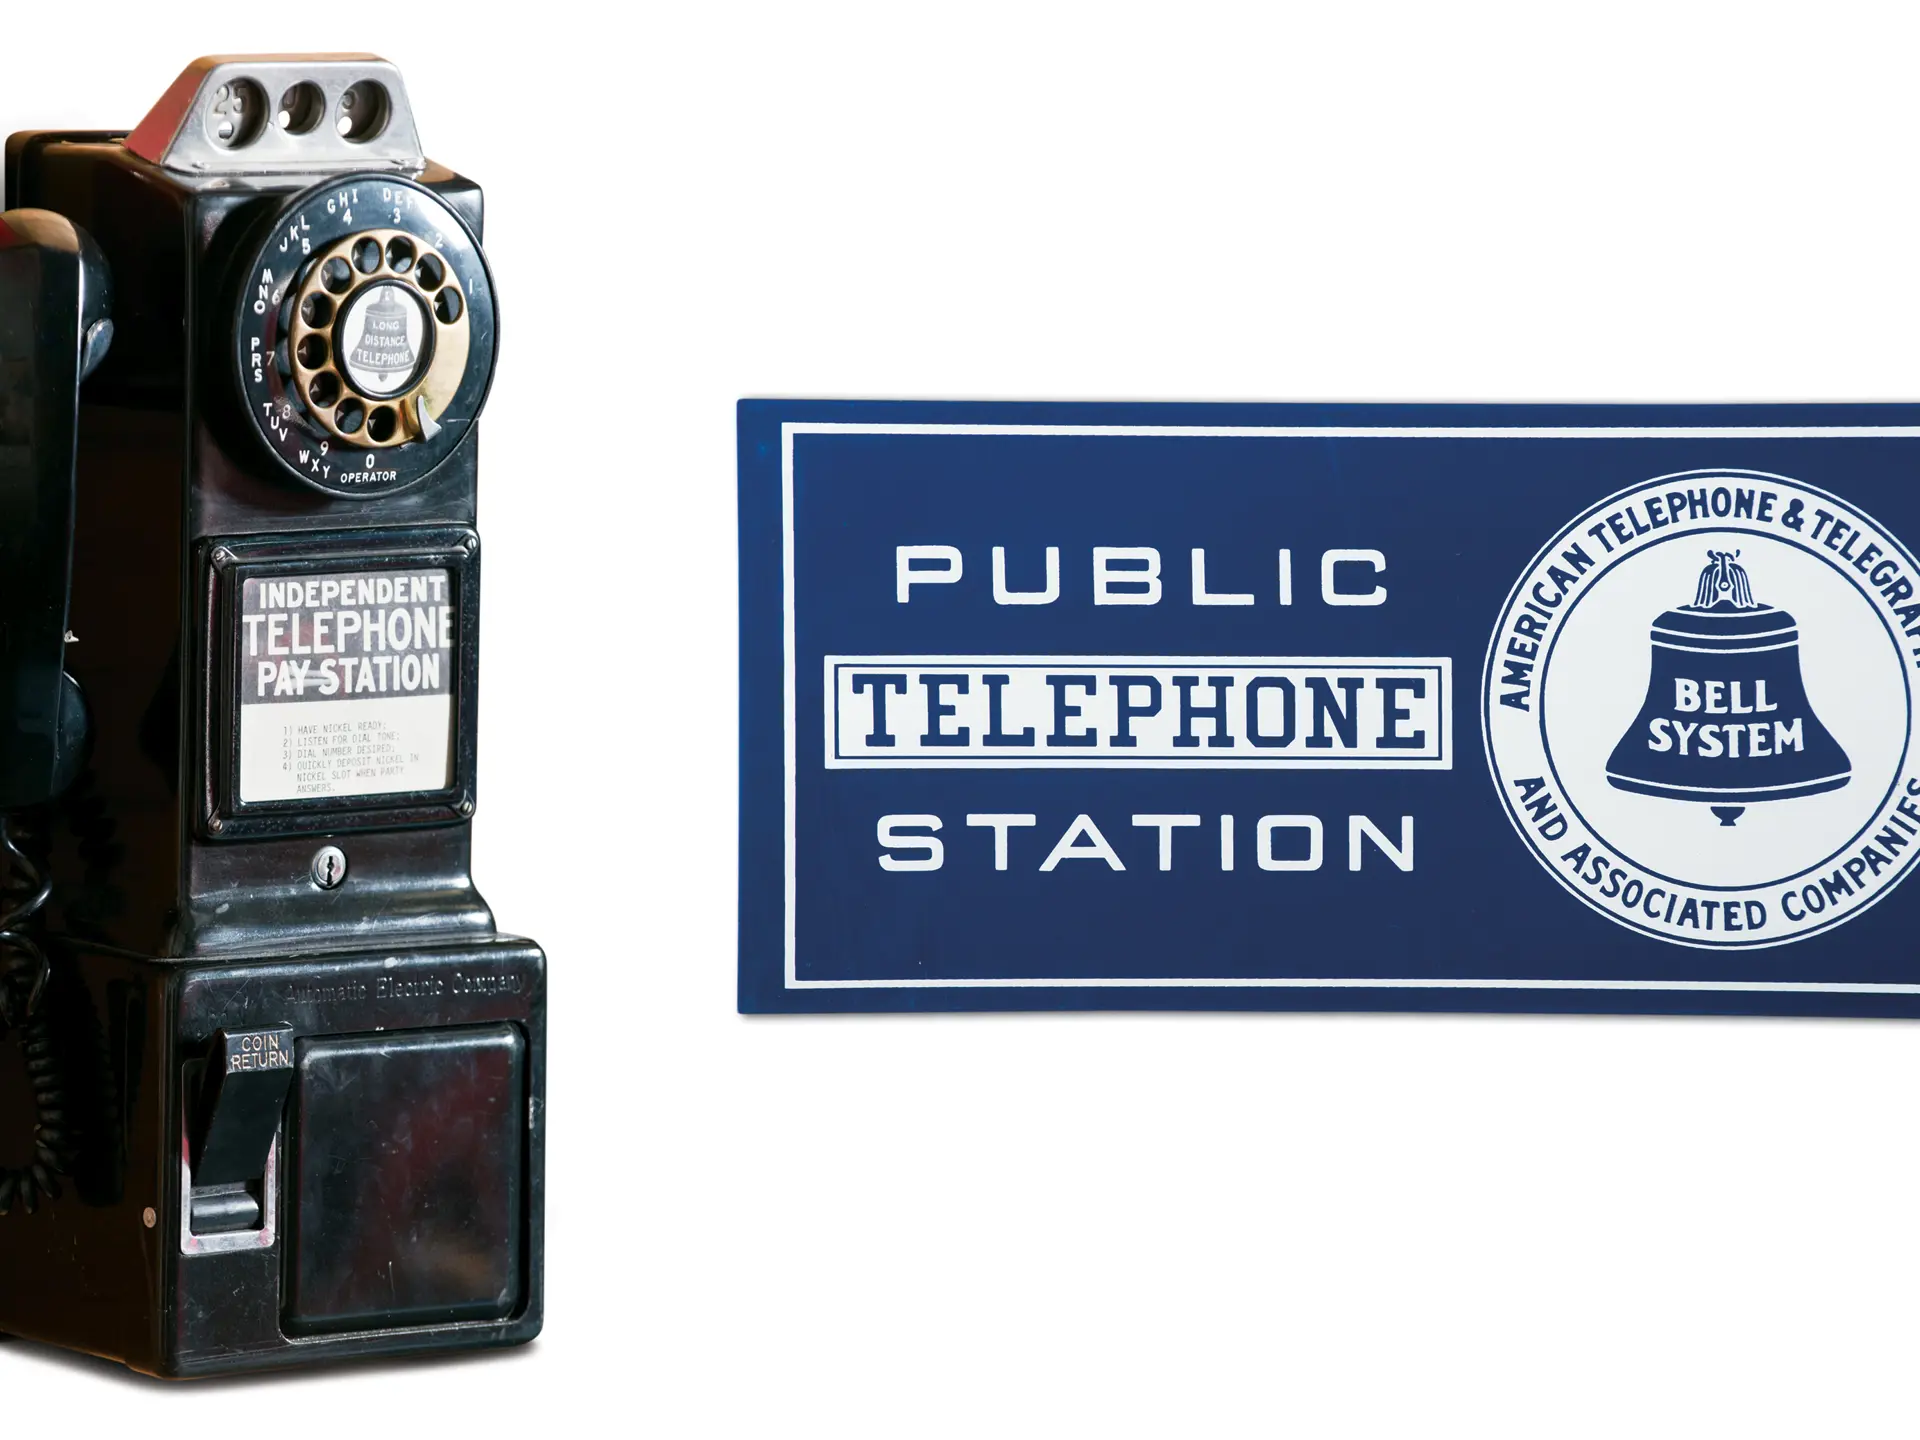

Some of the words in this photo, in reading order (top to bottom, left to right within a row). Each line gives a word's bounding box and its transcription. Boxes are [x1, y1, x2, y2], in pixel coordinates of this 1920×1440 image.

[327, 188, 359, 215] GHI
[343, 208, 352, 226] 4
[393, 207, 401, 224] 3
[279, 215, 310, 252] JKL
[434, 233, 444, 249] 2
[302, 238, 311, 255] 5
[253, 268, 273, 315] MNO
[271, 288, 280, 305] 6
[372, 320, 400, 331] LONG
[365, 334, 406, 348] DISTANCE
[251, 337, 263, 383] PRS
[266, 350, 275, 366] 7
[357, 348, 410, 365] TELEPHONE
[282, 404, 291, 419] 8
[263, 402, 288, 442] TUV
[320, 441, 329, 456] 9
[299, 450, 330, 479] WXY
[340, 470, 397, 484] OPERATOR
[896, 545, 1387, 605] PUBLIC
[259, 575, 445, 609] INDEPENDENT
[1500, 543, 1596, 712] AMERICAN
[1588, 487, 1777, 554] TELEPHONE
[1780, 498, 1805, 532] &
[1811, 508, 1920, 668] TELEGRA
[242, 606, 455, 656] TELEPHONE
[257, 659, 311, 697] PAY
[319, 653, 440, 696] STATION
[1674, 677, 1778, 714] BELL
[851, 673, 1426, 750] TELEPHONE
[298, 725, 318, 735] HAVE
[323, 723, 352, 733] NICKEL
[1647, 717, 1804, 758] SYSTEM
[283, 738, 292, 748] 2)
[297, 736, 328, 747] LISTEN
[332, 735, 348, 744] FOR
[352, 733, 371, 743] DIAL
[283, 749, 292, 760] 3)
[297, 749, 316, 759] DIAL
[322, 746, 352, 757] NUMBER
[283, 761, 292, 771] 4)
[297, 760, 332, 771] QUICKLY
[337, 756, 371, 768] DEPOSIT
[376, 754, 404, 765] NICKEL
[410, 752, 419, 762] IN
[297, 771, 326, 782] NICKEL
[332, 770, 351, 780] SLOT
[356, 768, 376, 777] WHEN
[381, 766, 404, 777] PARTY
[296, 783, 336, 794] ANSWERS.
[877, 813, 1414, 872] STATION
[1513, 776, 1568, 841] AND
[1561, 843, 1767, 931] ASSOCIATED
[284, 980, 367, 1004] Automatic
[376, 975, 444, 999] Electric
[452, 972, 523, 996] Company
[241, 1034, 279, 1051] COIN
[230, 1049, 289, 1070] RETURN
